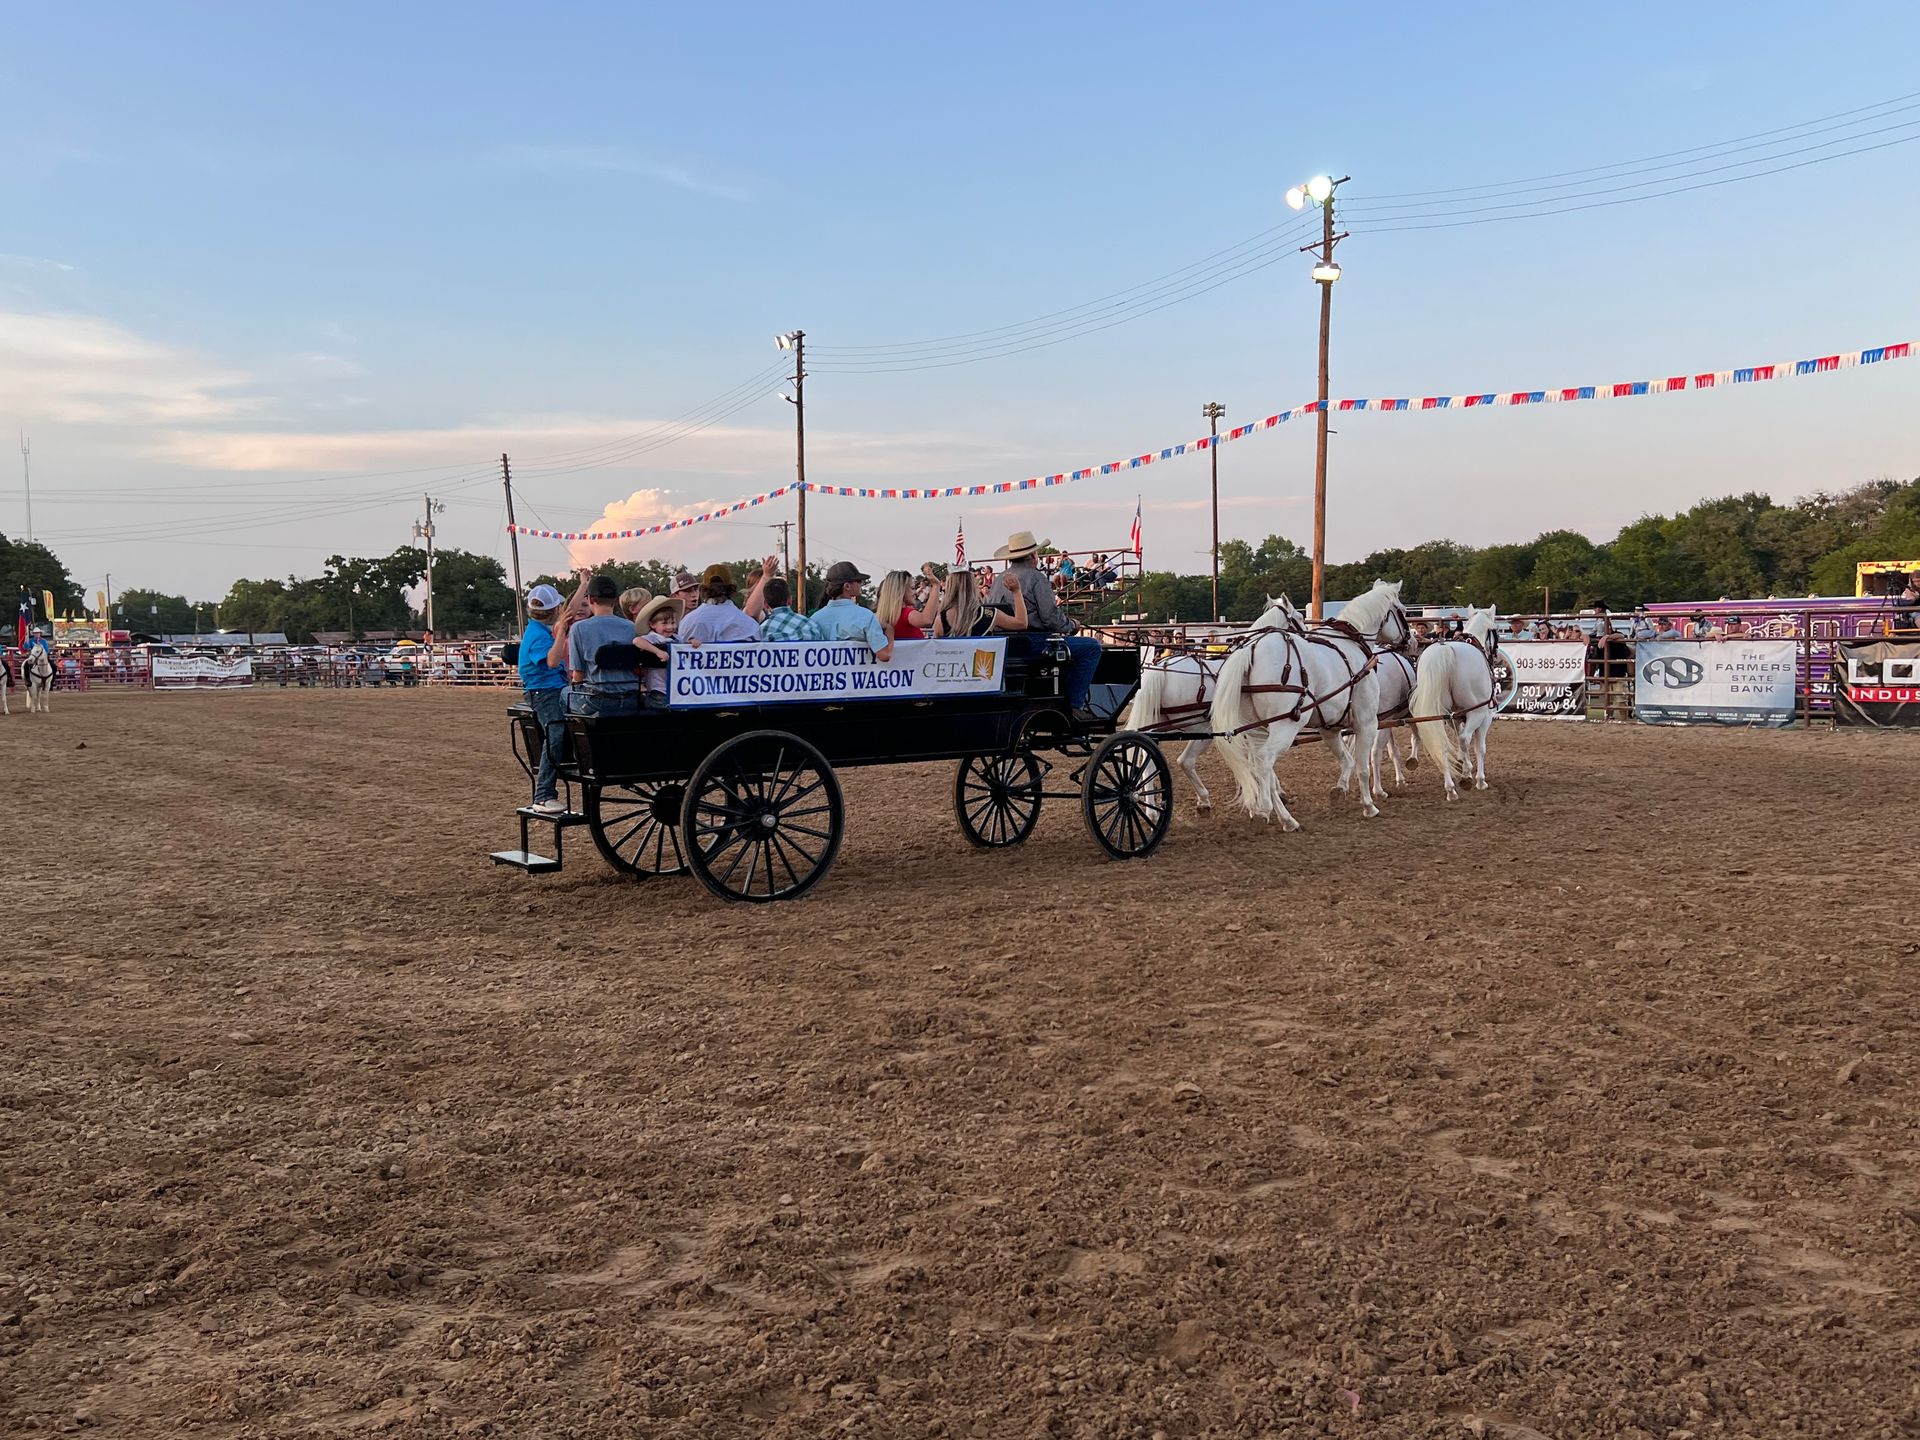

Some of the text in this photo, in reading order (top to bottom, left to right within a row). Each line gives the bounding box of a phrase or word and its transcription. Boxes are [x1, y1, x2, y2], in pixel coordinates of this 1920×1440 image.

[677, 649, 800, 670] FREESTONE
[1516, 658, 1582, 669] 903-389-5555
[922, 662, 969, 678] CETA
[1716, 663, 1791, 672] FARMERS
[677, 669, 915, 696] COMMISSIONERS WAGON
[1730, 685, 1775, 693] BANK
[1521, 685, 1573, 698] 901 W US
[1516, 698, 1577, 712] Highway 84
